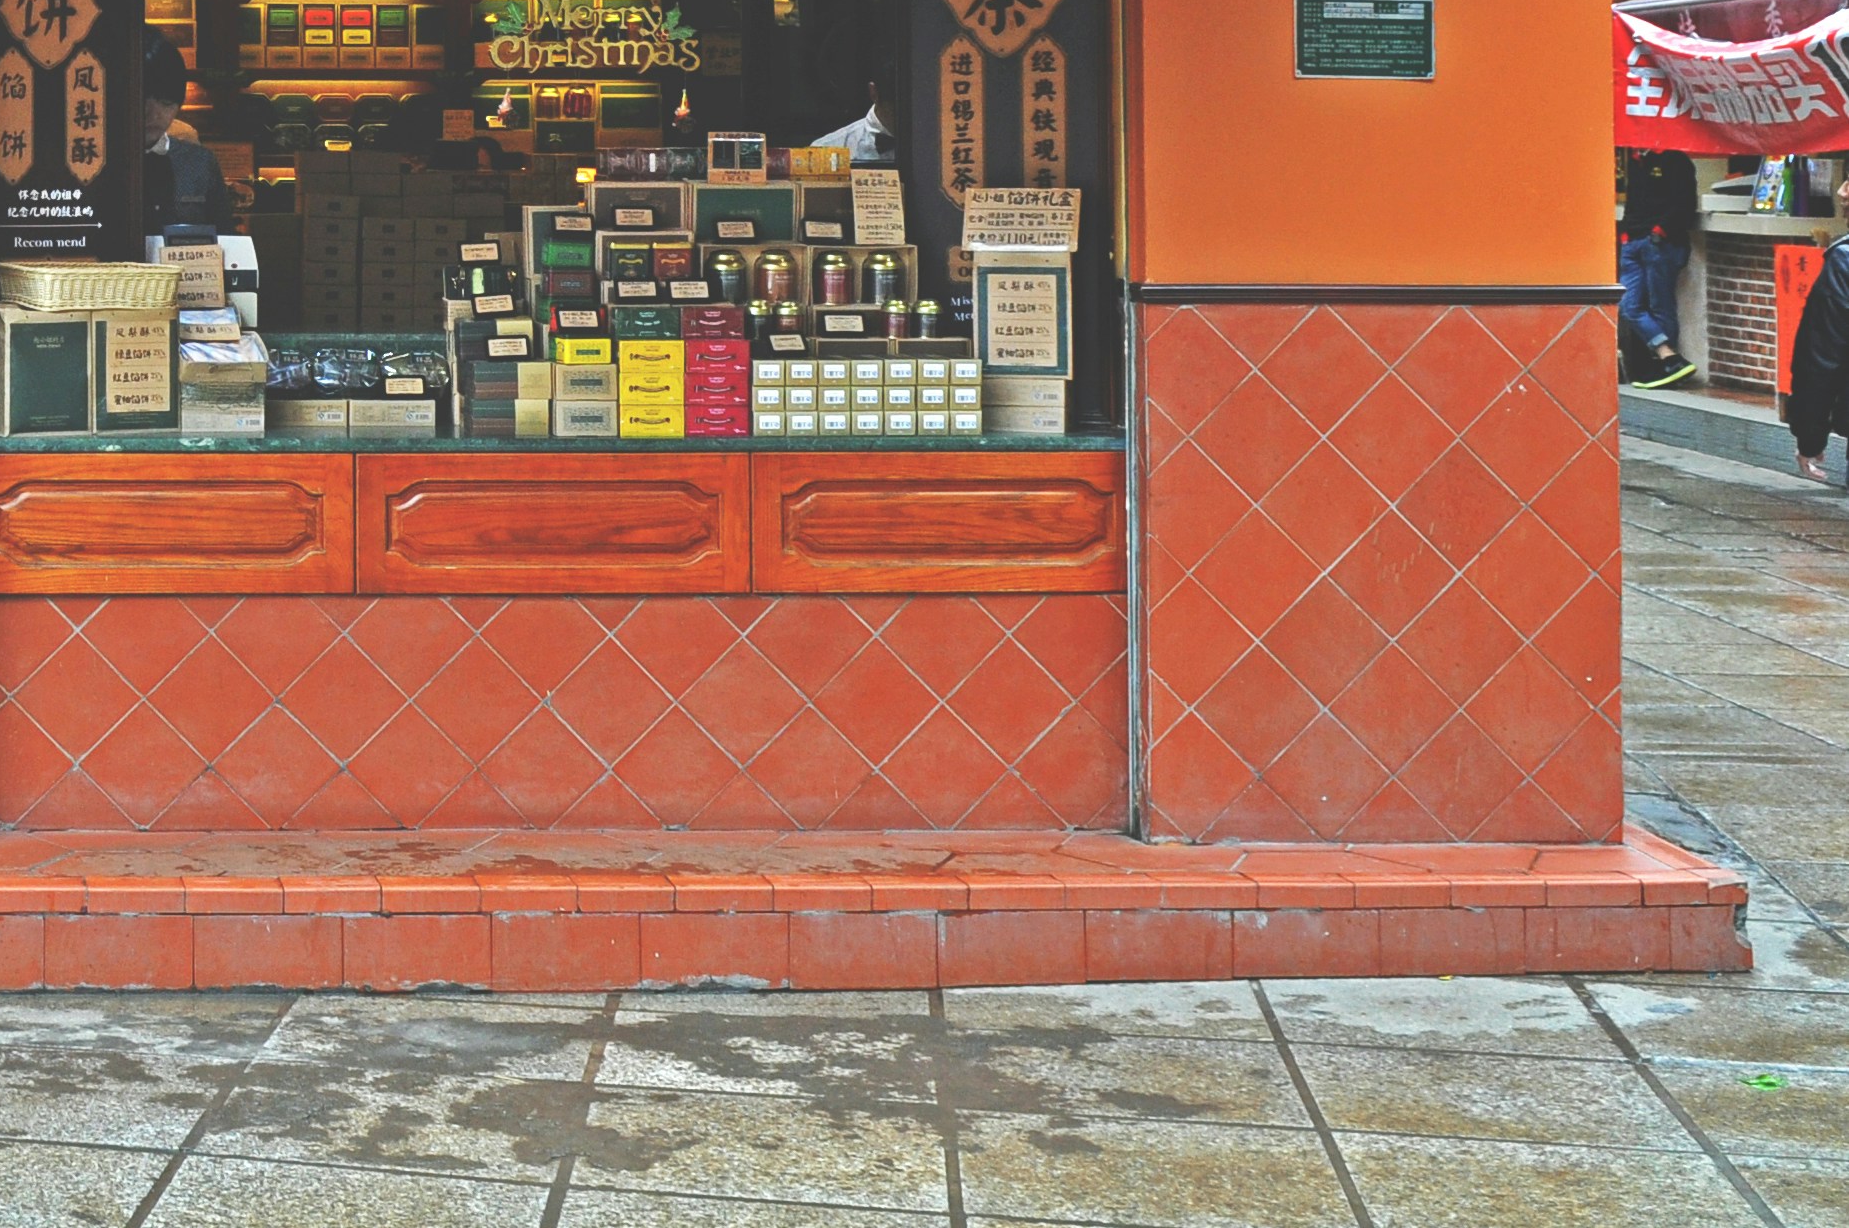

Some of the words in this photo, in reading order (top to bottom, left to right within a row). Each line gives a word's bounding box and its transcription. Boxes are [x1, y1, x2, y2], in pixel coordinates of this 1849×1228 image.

[489, 35, 701, 73] Christmas
[0, 73, 27, 160] 馅饼
[71, 65, 100, 166] 凤梨酥
[950, 53, 976, 192] 进口锡兰红茶
[1008, 190, 1075, 207] 馅饼礼盒
